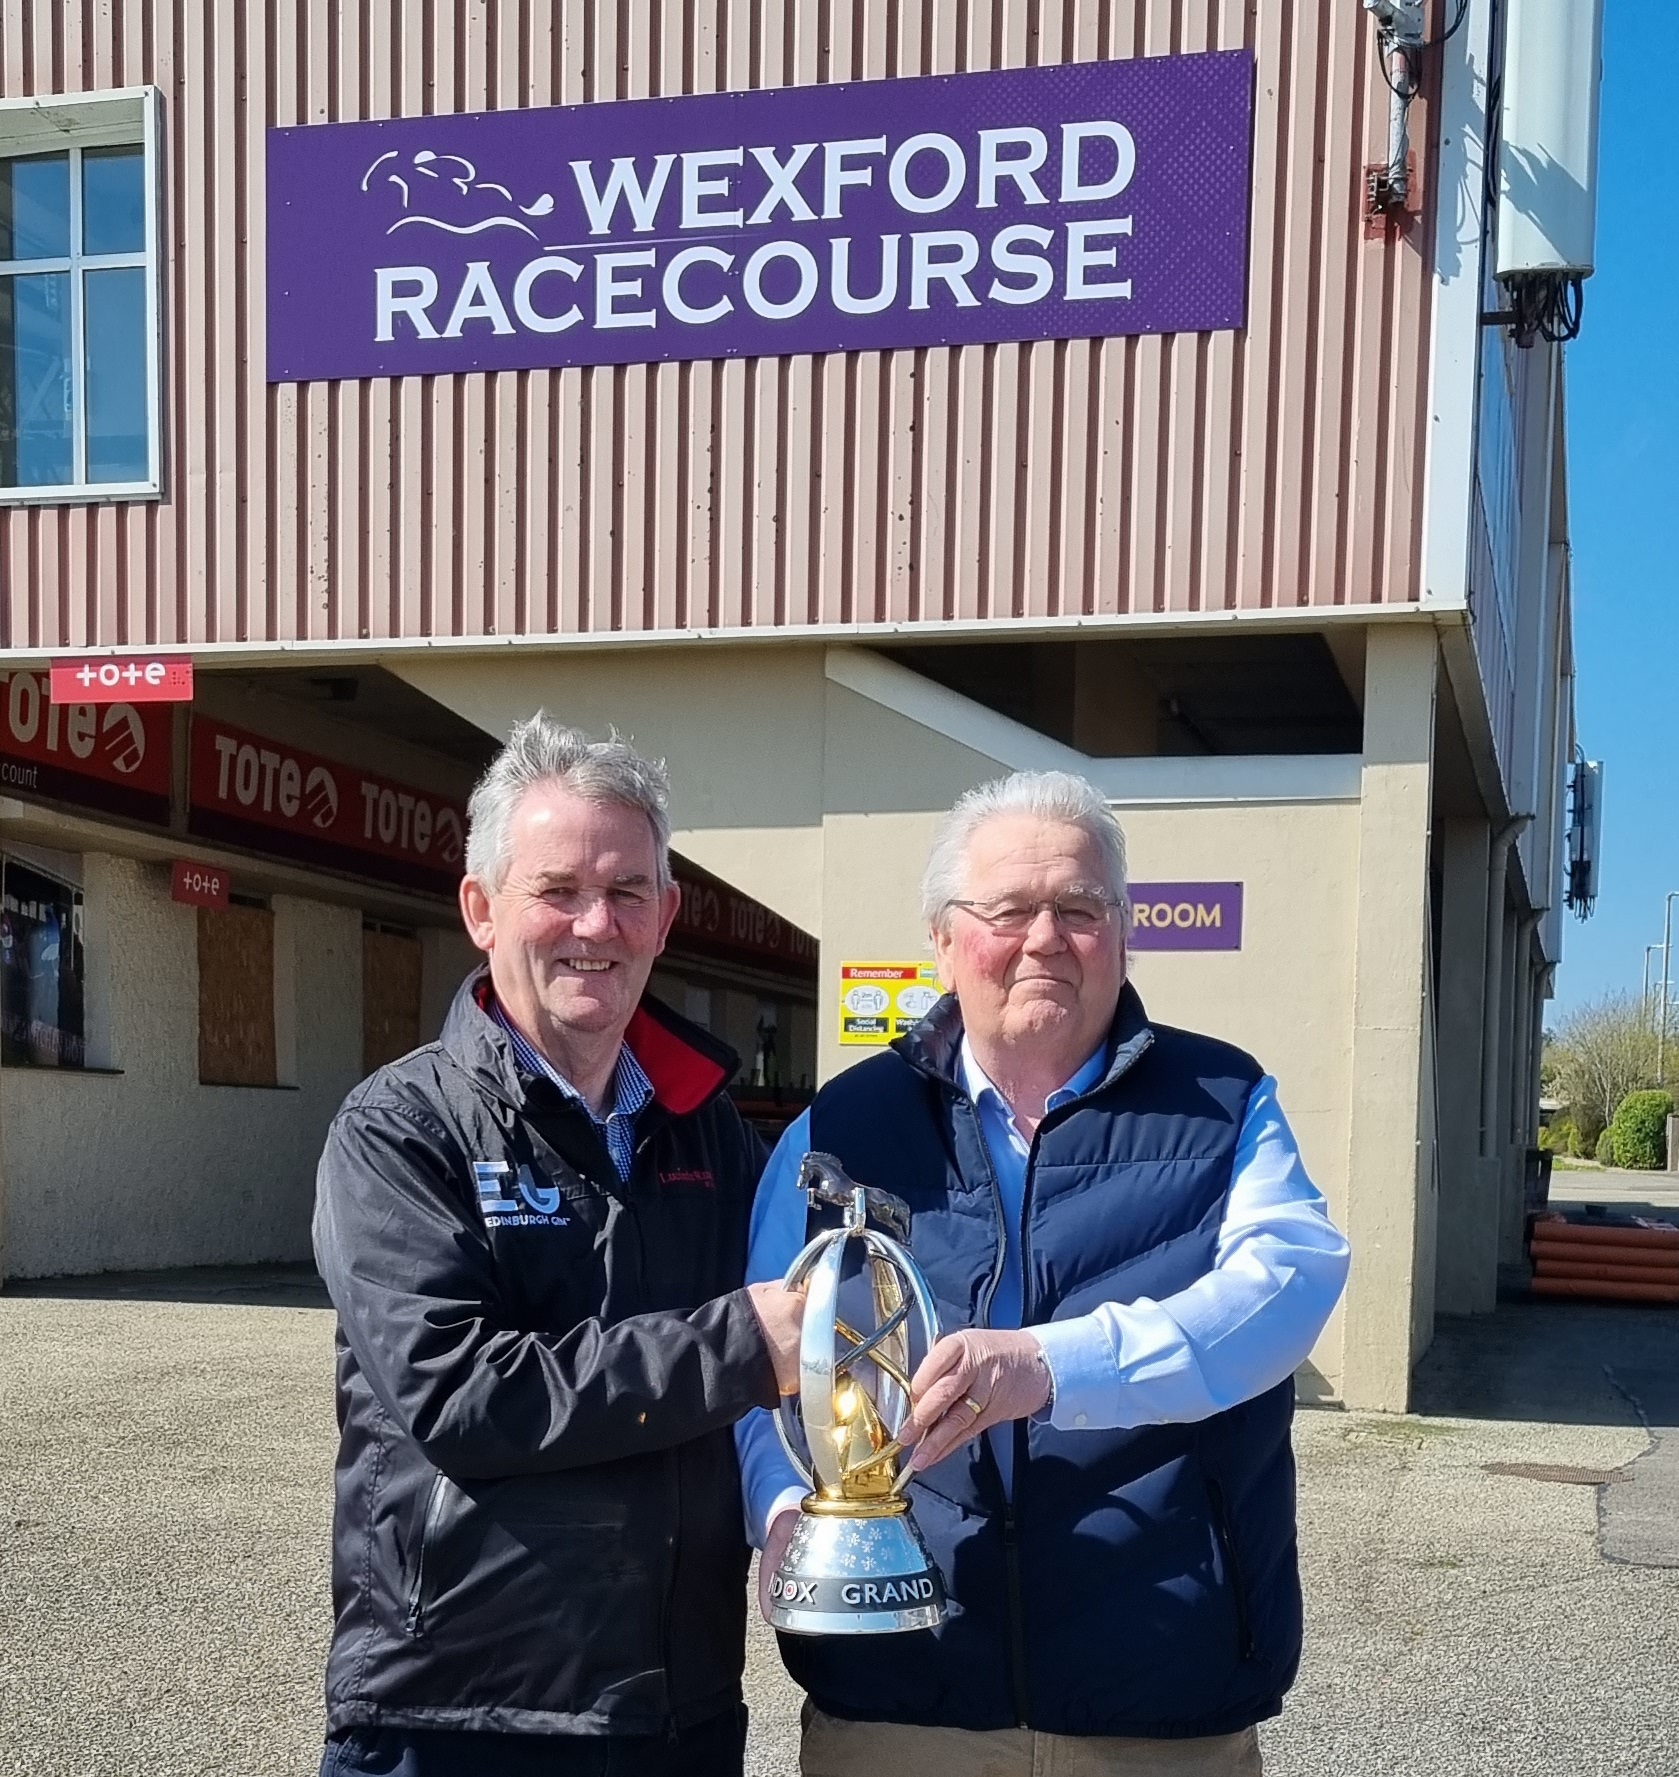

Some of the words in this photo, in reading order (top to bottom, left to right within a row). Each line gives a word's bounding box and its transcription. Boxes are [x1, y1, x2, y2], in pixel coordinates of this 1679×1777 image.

[569, 120, 1137, 235] WEXFORD
[373, 217, 1133, 342] RACECOURSE
[76, 661, 166, 687] tote
[1, 763, 38, 788] count
[183, 871, 220, 896] tote
[1132, 902, 1222, 928] ROOM
[850, 968, 904, 979] Remember
[484, 1214, 549, 1228] EDINBURGH
[768, 1573, 815, 1602] DOX
[841, 1578, 934, 1605] GRAND
